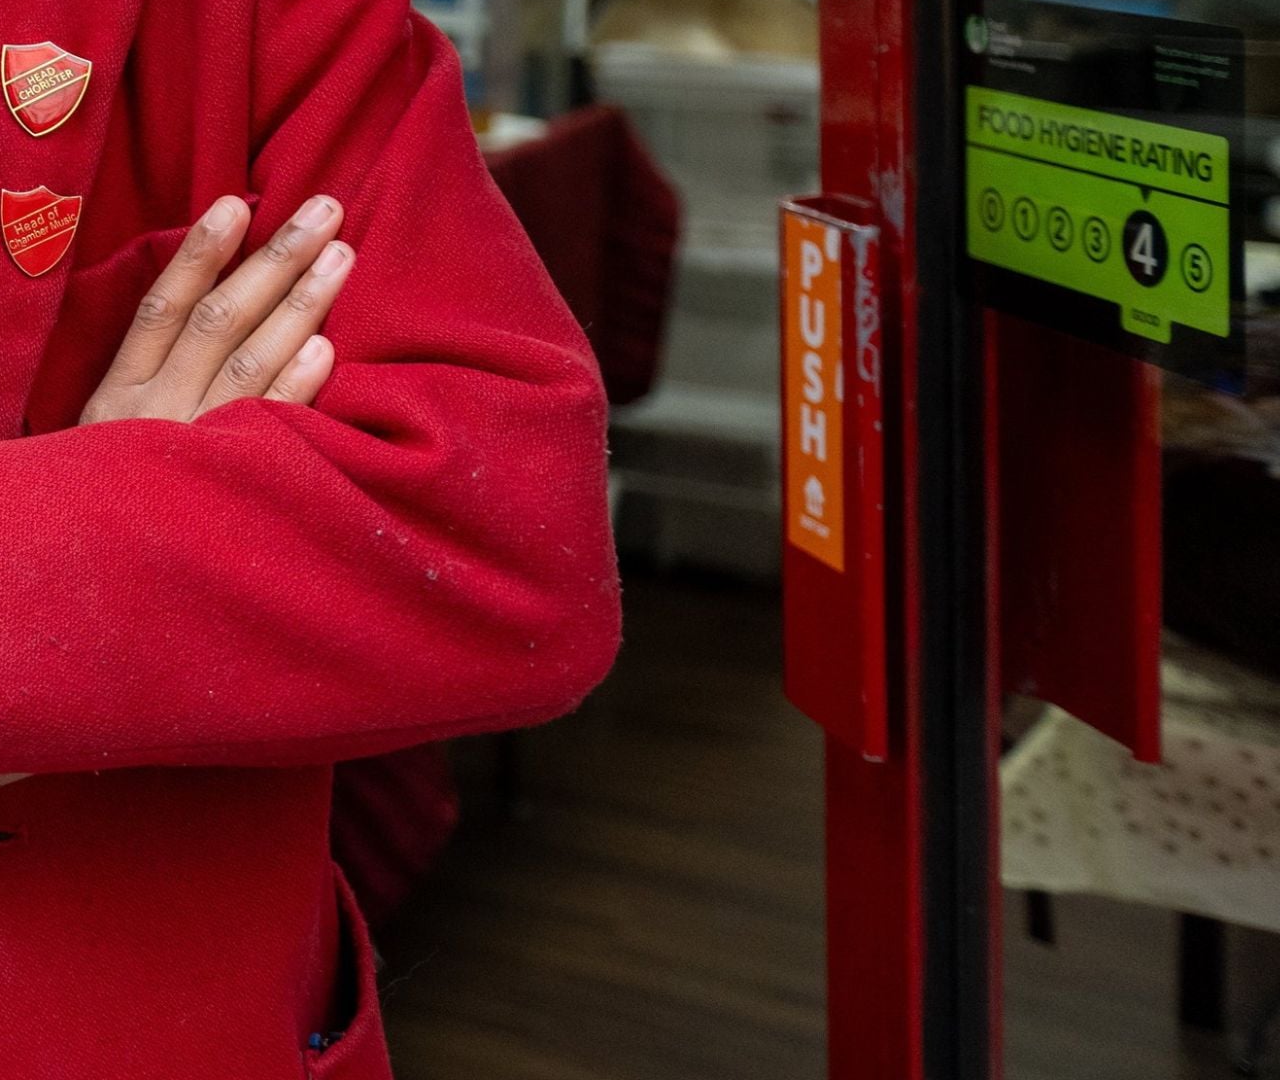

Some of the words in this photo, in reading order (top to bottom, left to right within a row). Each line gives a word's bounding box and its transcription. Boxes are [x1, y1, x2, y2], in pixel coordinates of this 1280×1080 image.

[19, 69, 74, 100] CHORISTER
[26, 67, 56, 86] HEAD
[978, 103, 1035, 141] FOOD
[1040, 121, 1127, 163] HYGIENE
[1131, 138, 1214, 182] RATING
[9, 225, 49, 249] Chamber
[49, 213, 77, 231] Music
[13, 213, 45, 235] Head
[48, 206, 59, 220] of
[1131, 222, 1159, 276] 4
[799, 239, 827, 462] PUSH
